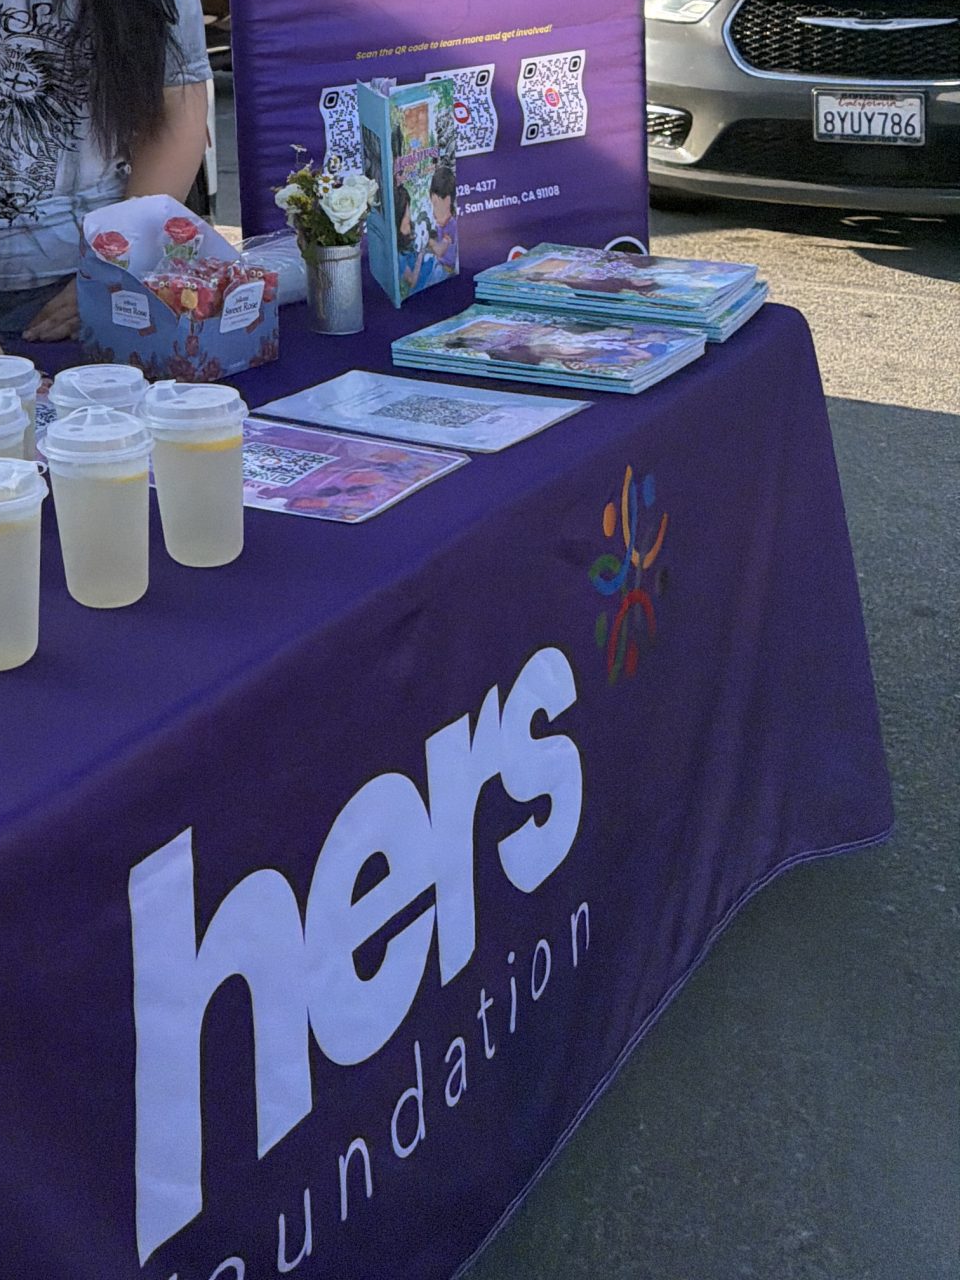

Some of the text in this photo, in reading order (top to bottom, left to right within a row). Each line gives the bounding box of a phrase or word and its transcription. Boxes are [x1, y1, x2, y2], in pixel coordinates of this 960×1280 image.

[356, 51, 377, 60] Scan
[379, 48, 393, 57] the
[395, 46, 407, 55] QR
[408, 43, 428, 53] code
[440, 39, 461, 48] learn
[463, 36, 483, 45] more
[485, 32, 501, 42] and
[502, 30, 515, 42] get
[516, 24, 552, 37] involved!
[824, 111, 916, 136] 8YUY786
[465, 202, 483, 213] San
[485, 195, 521, 209] Marino,
[521, 192, 536, 202] CA
[536, 185, 560, 199] 91108
[128, 645, 583, 1268] hers
[166, 900, 590, 1280] undation
